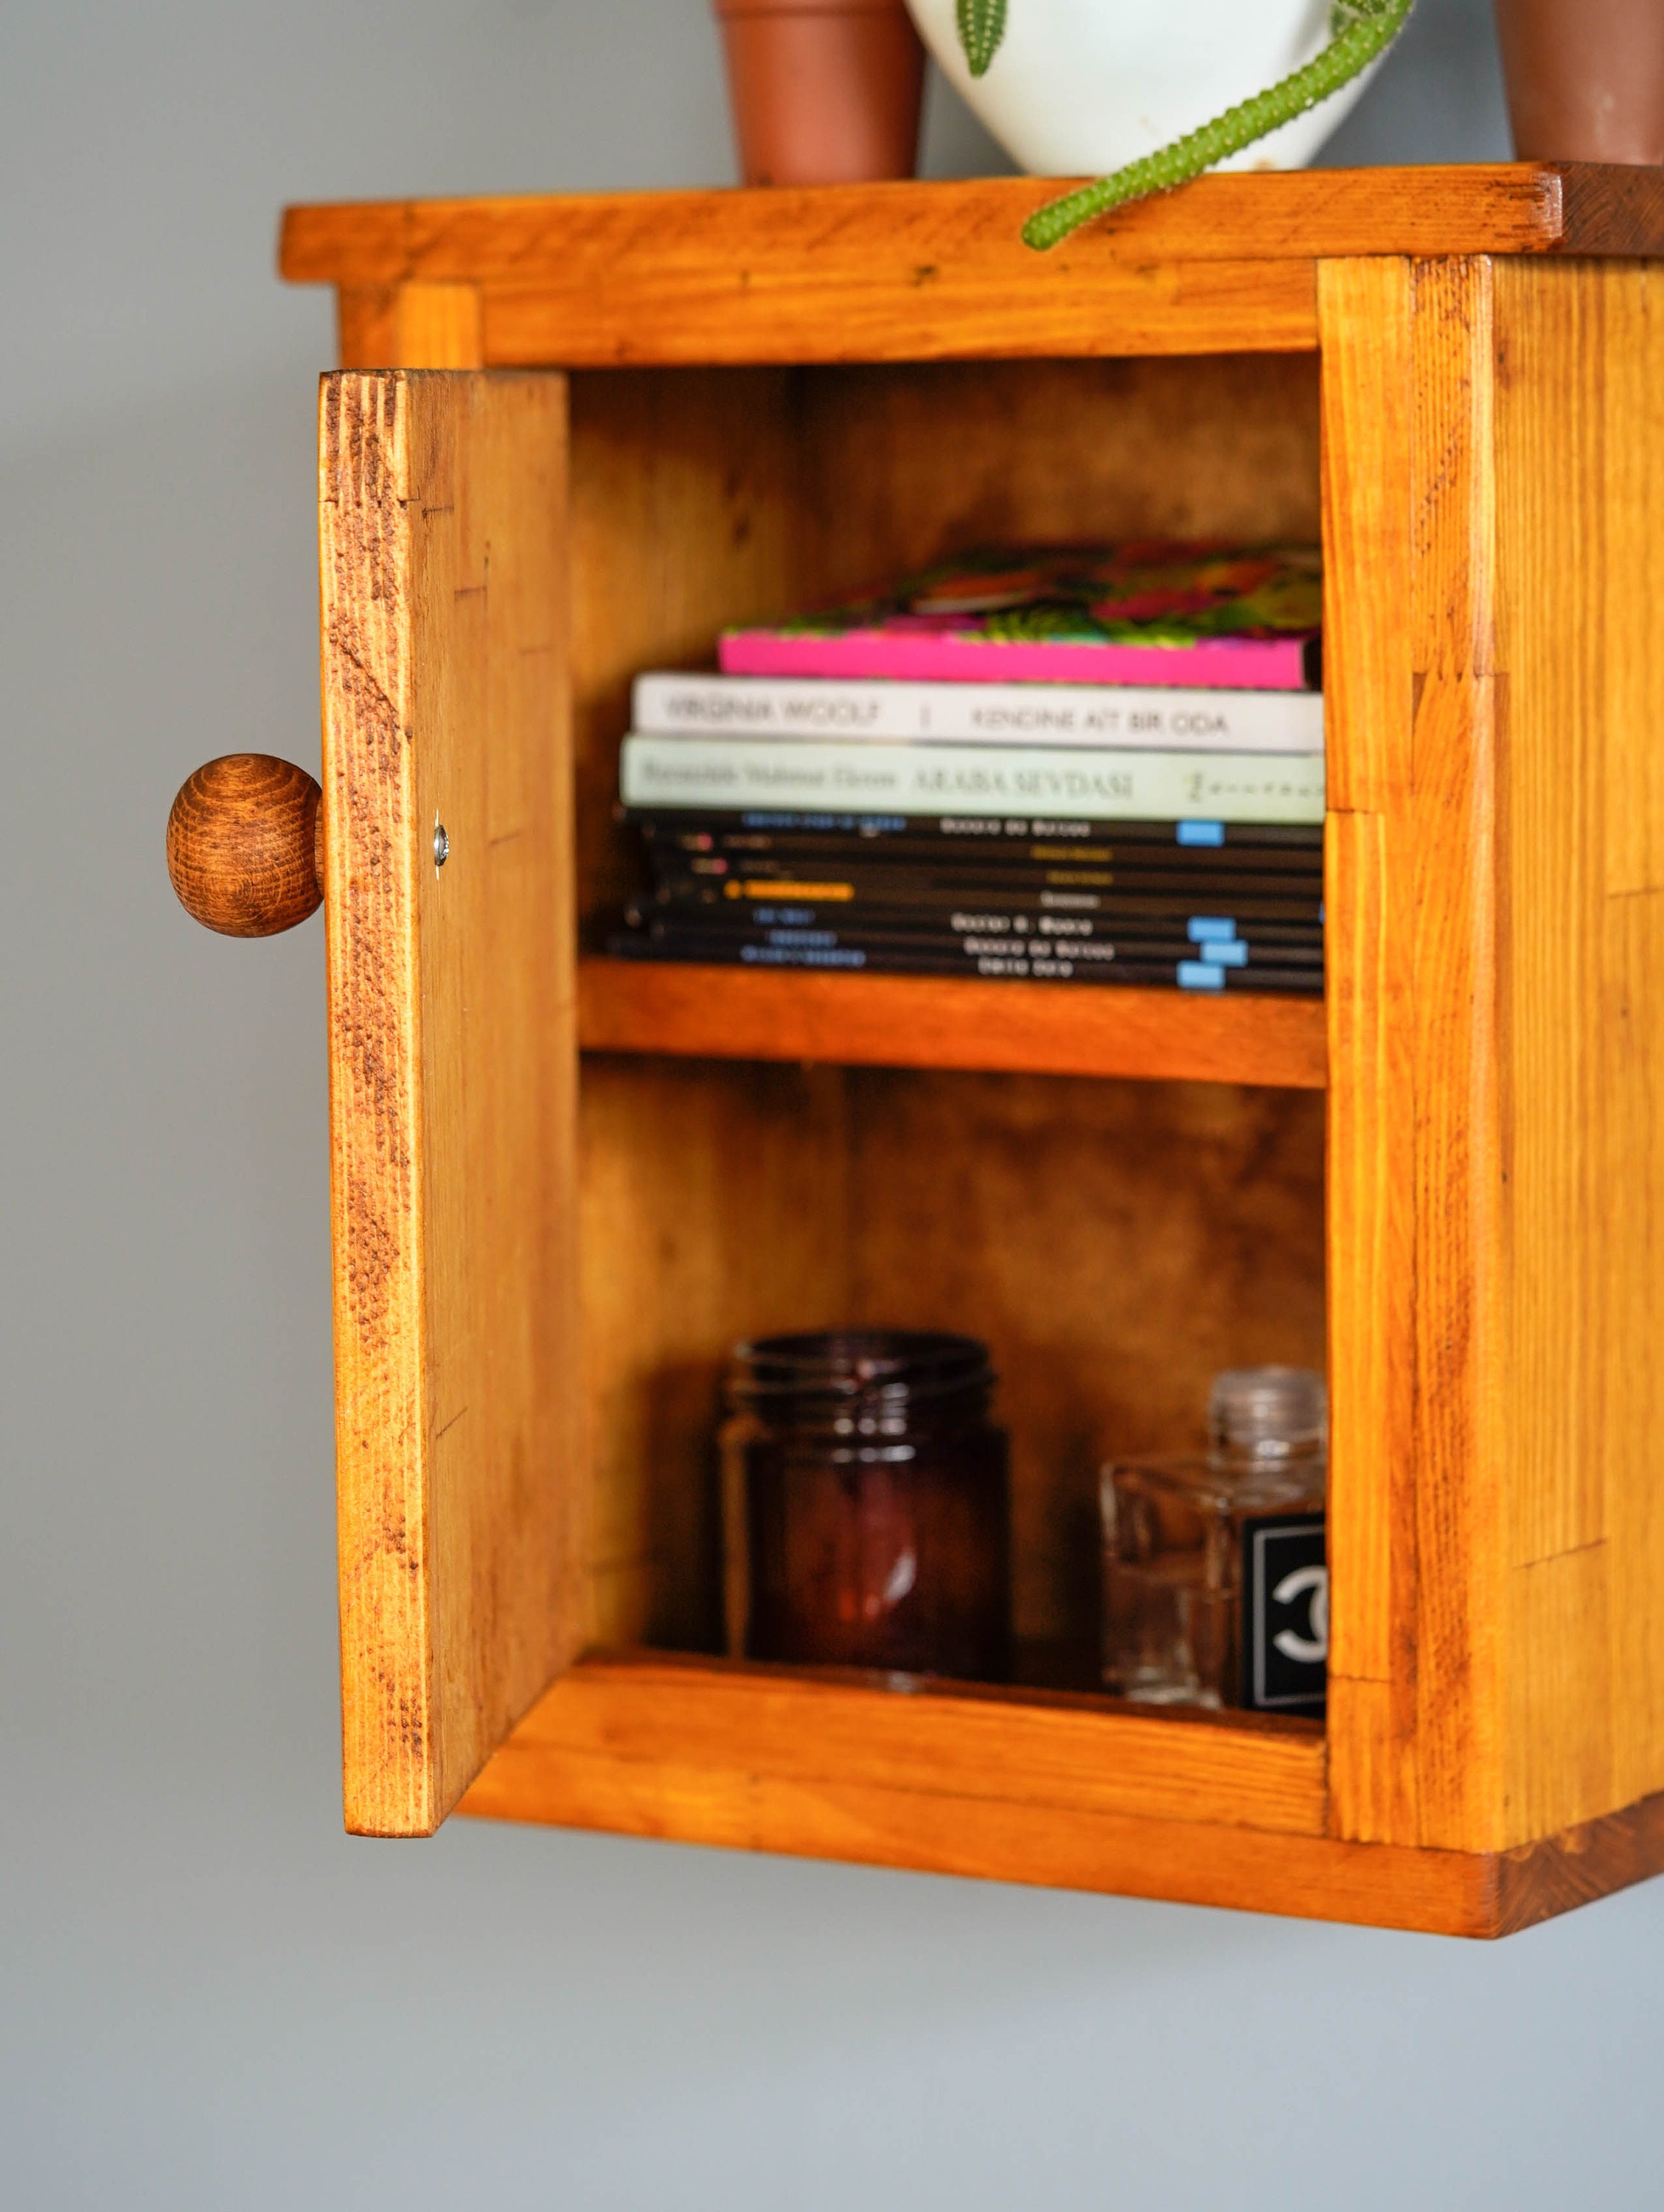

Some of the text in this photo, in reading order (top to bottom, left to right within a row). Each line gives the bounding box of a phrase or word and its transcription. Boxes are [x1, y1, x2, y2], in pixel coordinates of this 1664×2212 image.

[665, 695, 880, 726] VIRGINIA WOOLF
[1171, 712, 1230, 735] ODA
[911, 766, 1009, 795] ARABA
